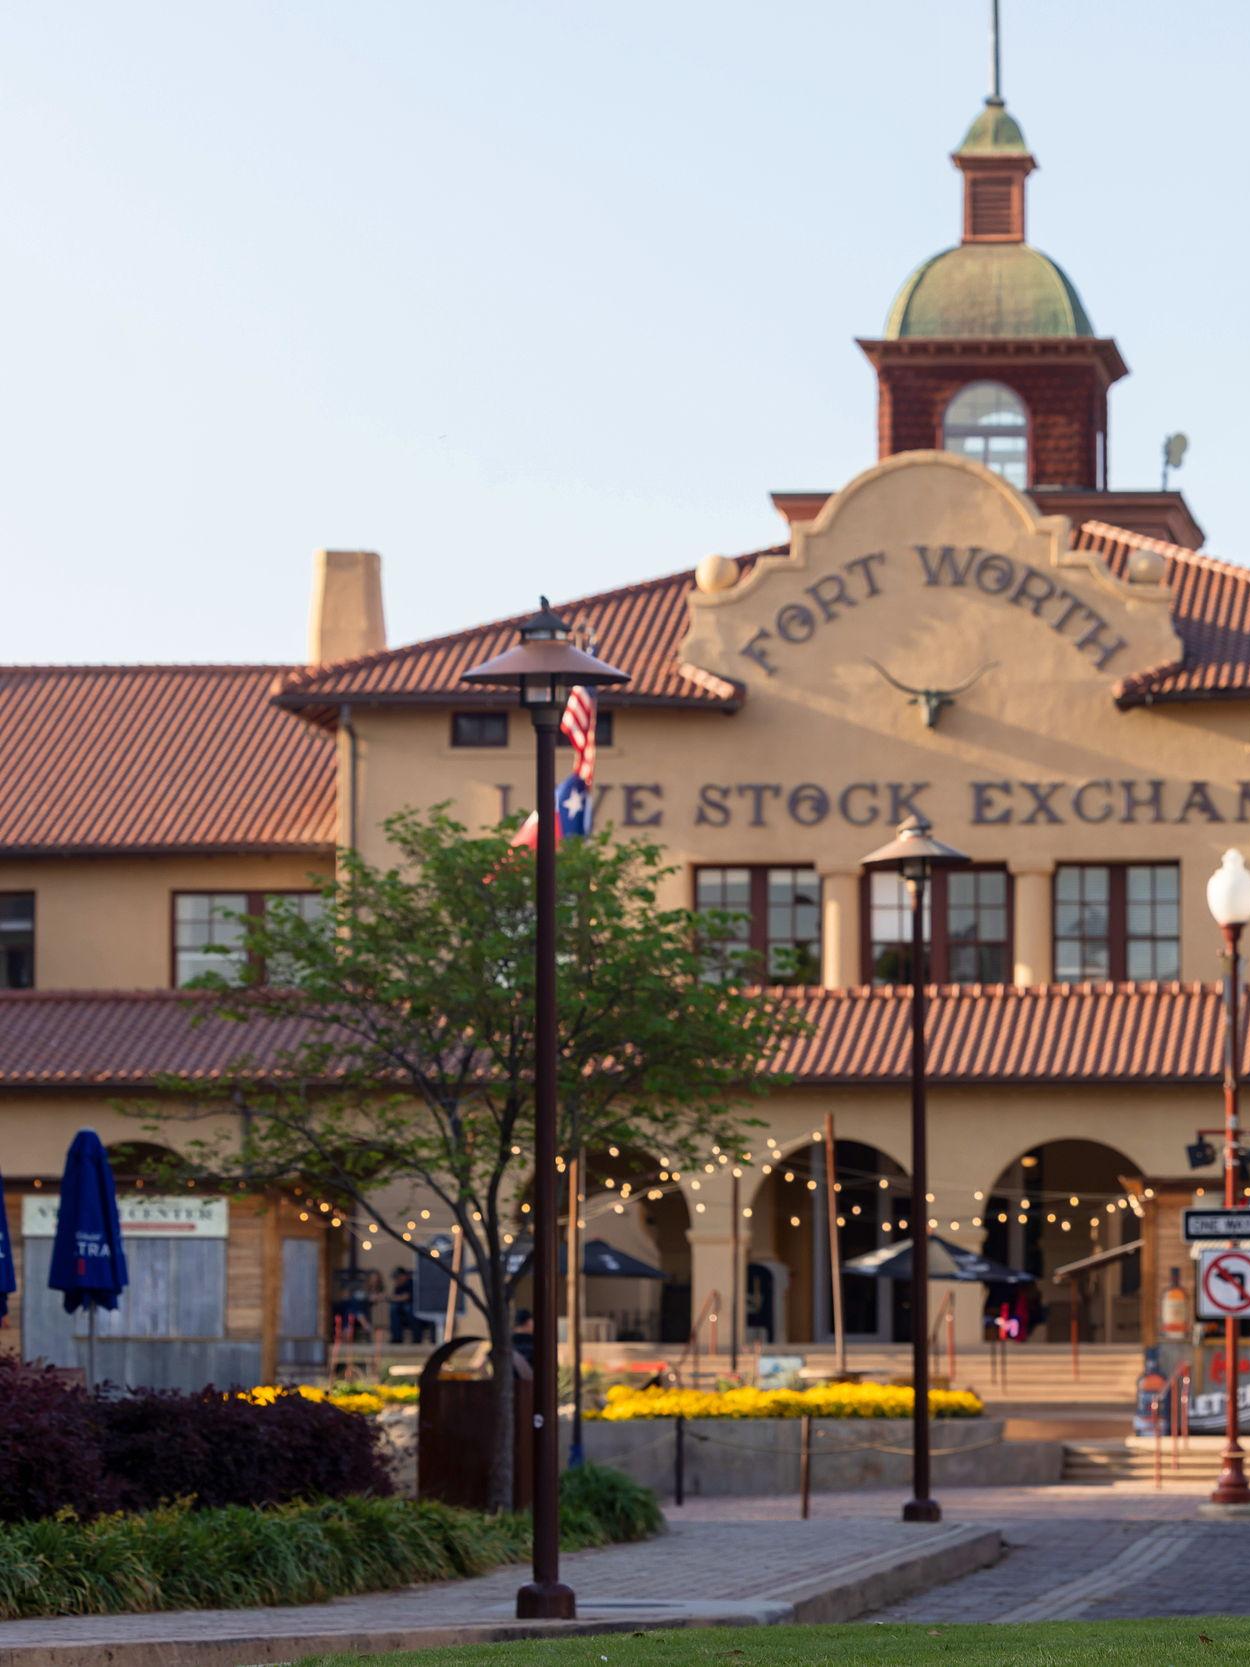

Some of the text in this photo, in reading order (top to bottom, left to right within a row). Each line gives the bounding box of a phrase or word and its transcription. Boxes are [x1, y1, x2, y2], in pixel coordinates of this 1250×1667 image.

[740, 544, 1128, 677] FORT WORTH
[694, 781, 932, 828] STOCK
